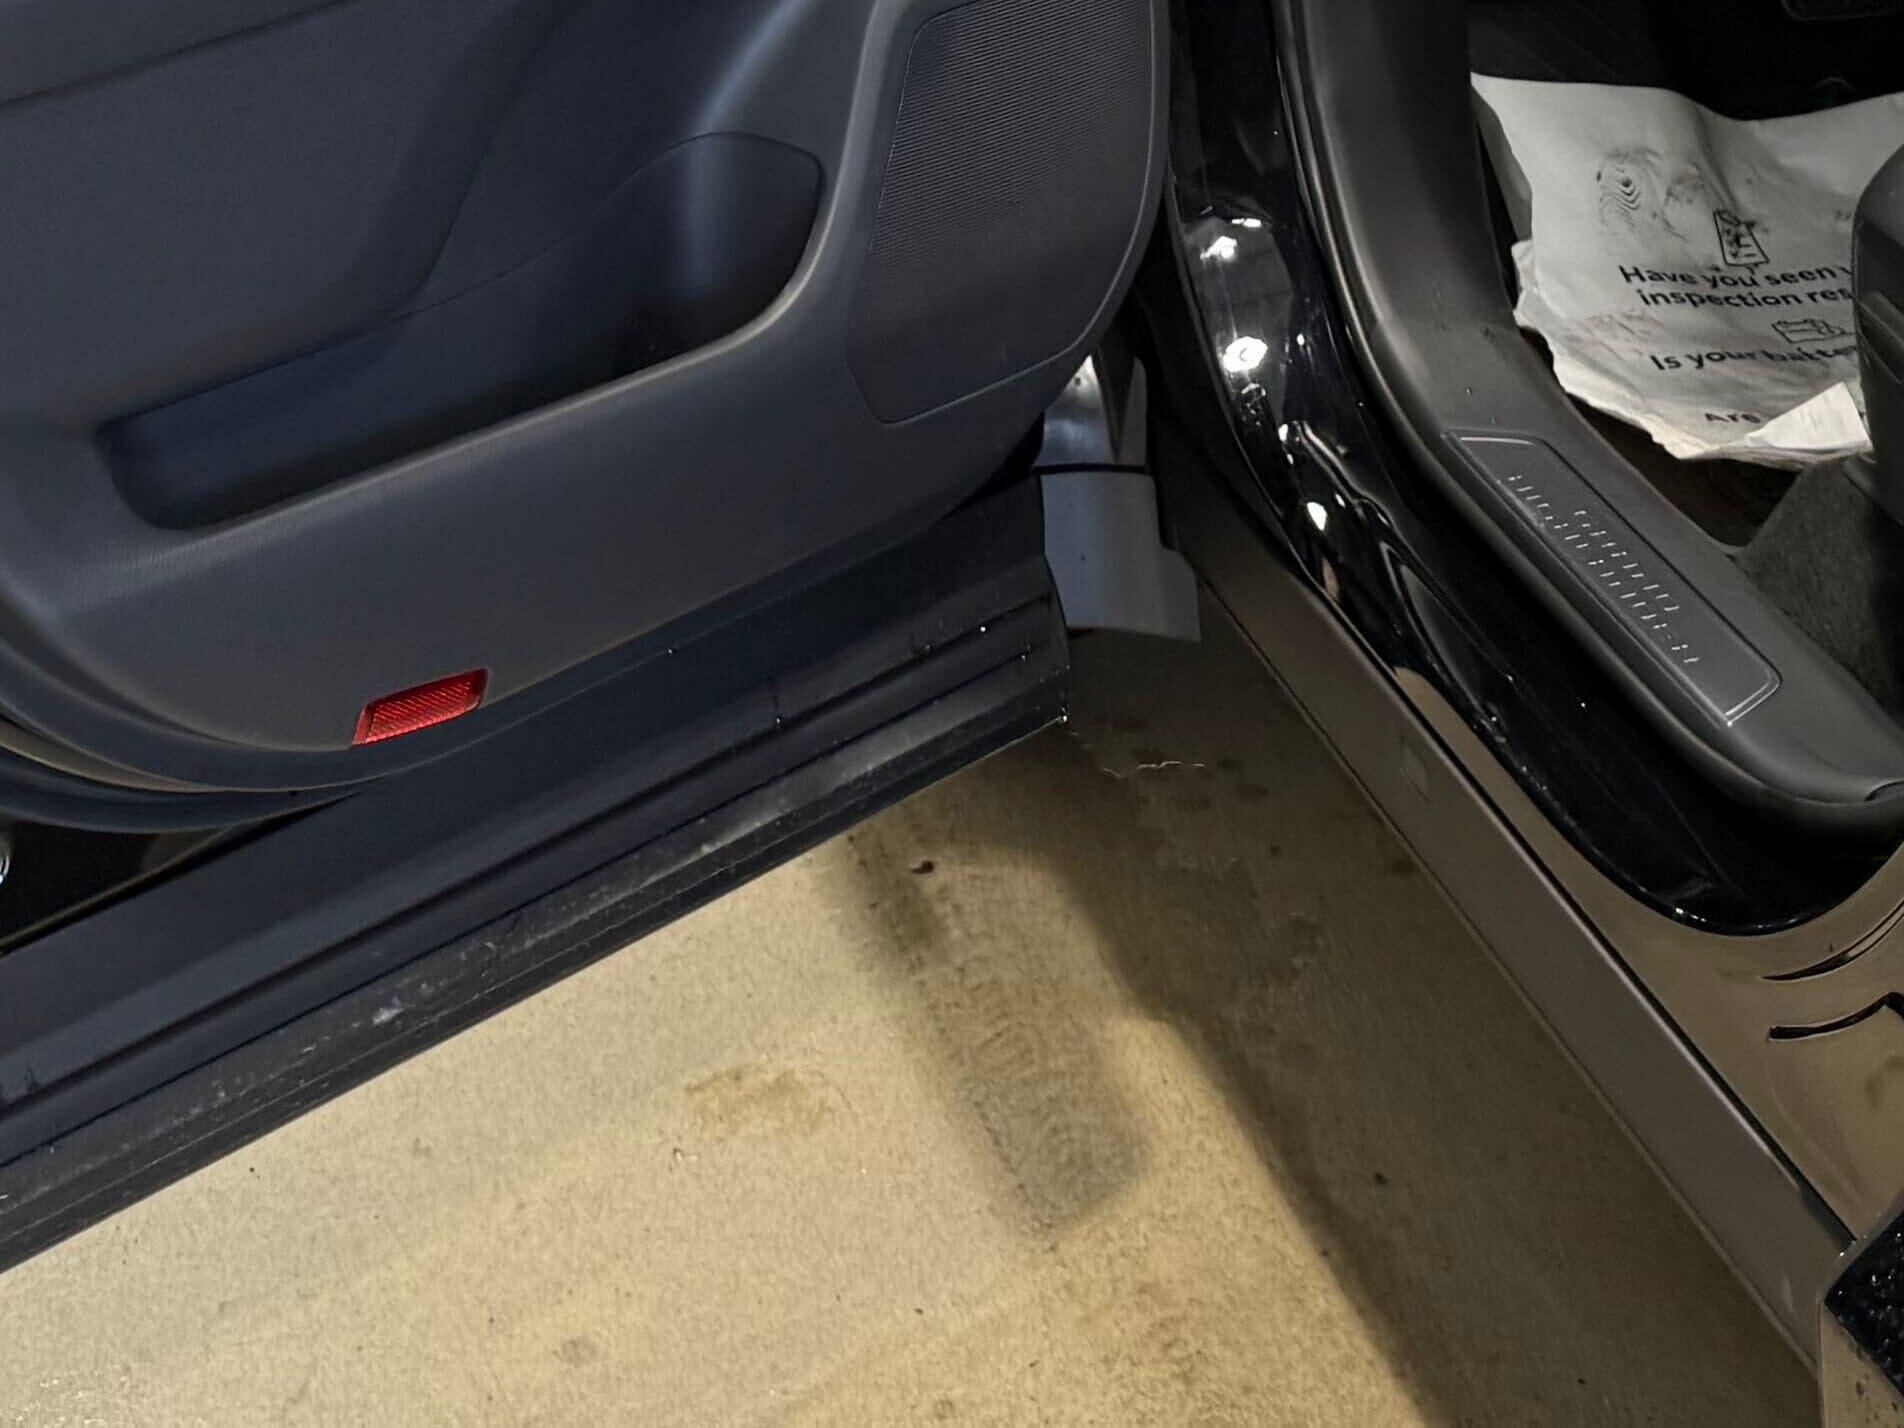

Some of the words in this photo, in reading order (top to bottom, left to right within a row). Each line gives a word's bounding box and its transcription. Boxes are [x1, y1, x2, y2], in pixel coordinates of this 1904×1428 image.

[1618, 265, 1697, 284] Have
[1701, 272, 1759, 289] you
[1764, 267, 1838, 285] seen
[1636, 288, 1802, 307] inspection
[1809, 287, 1854, 302] res
[1649, 354, 1681, 370] Is
[1684, 350, 1758, 370] your
